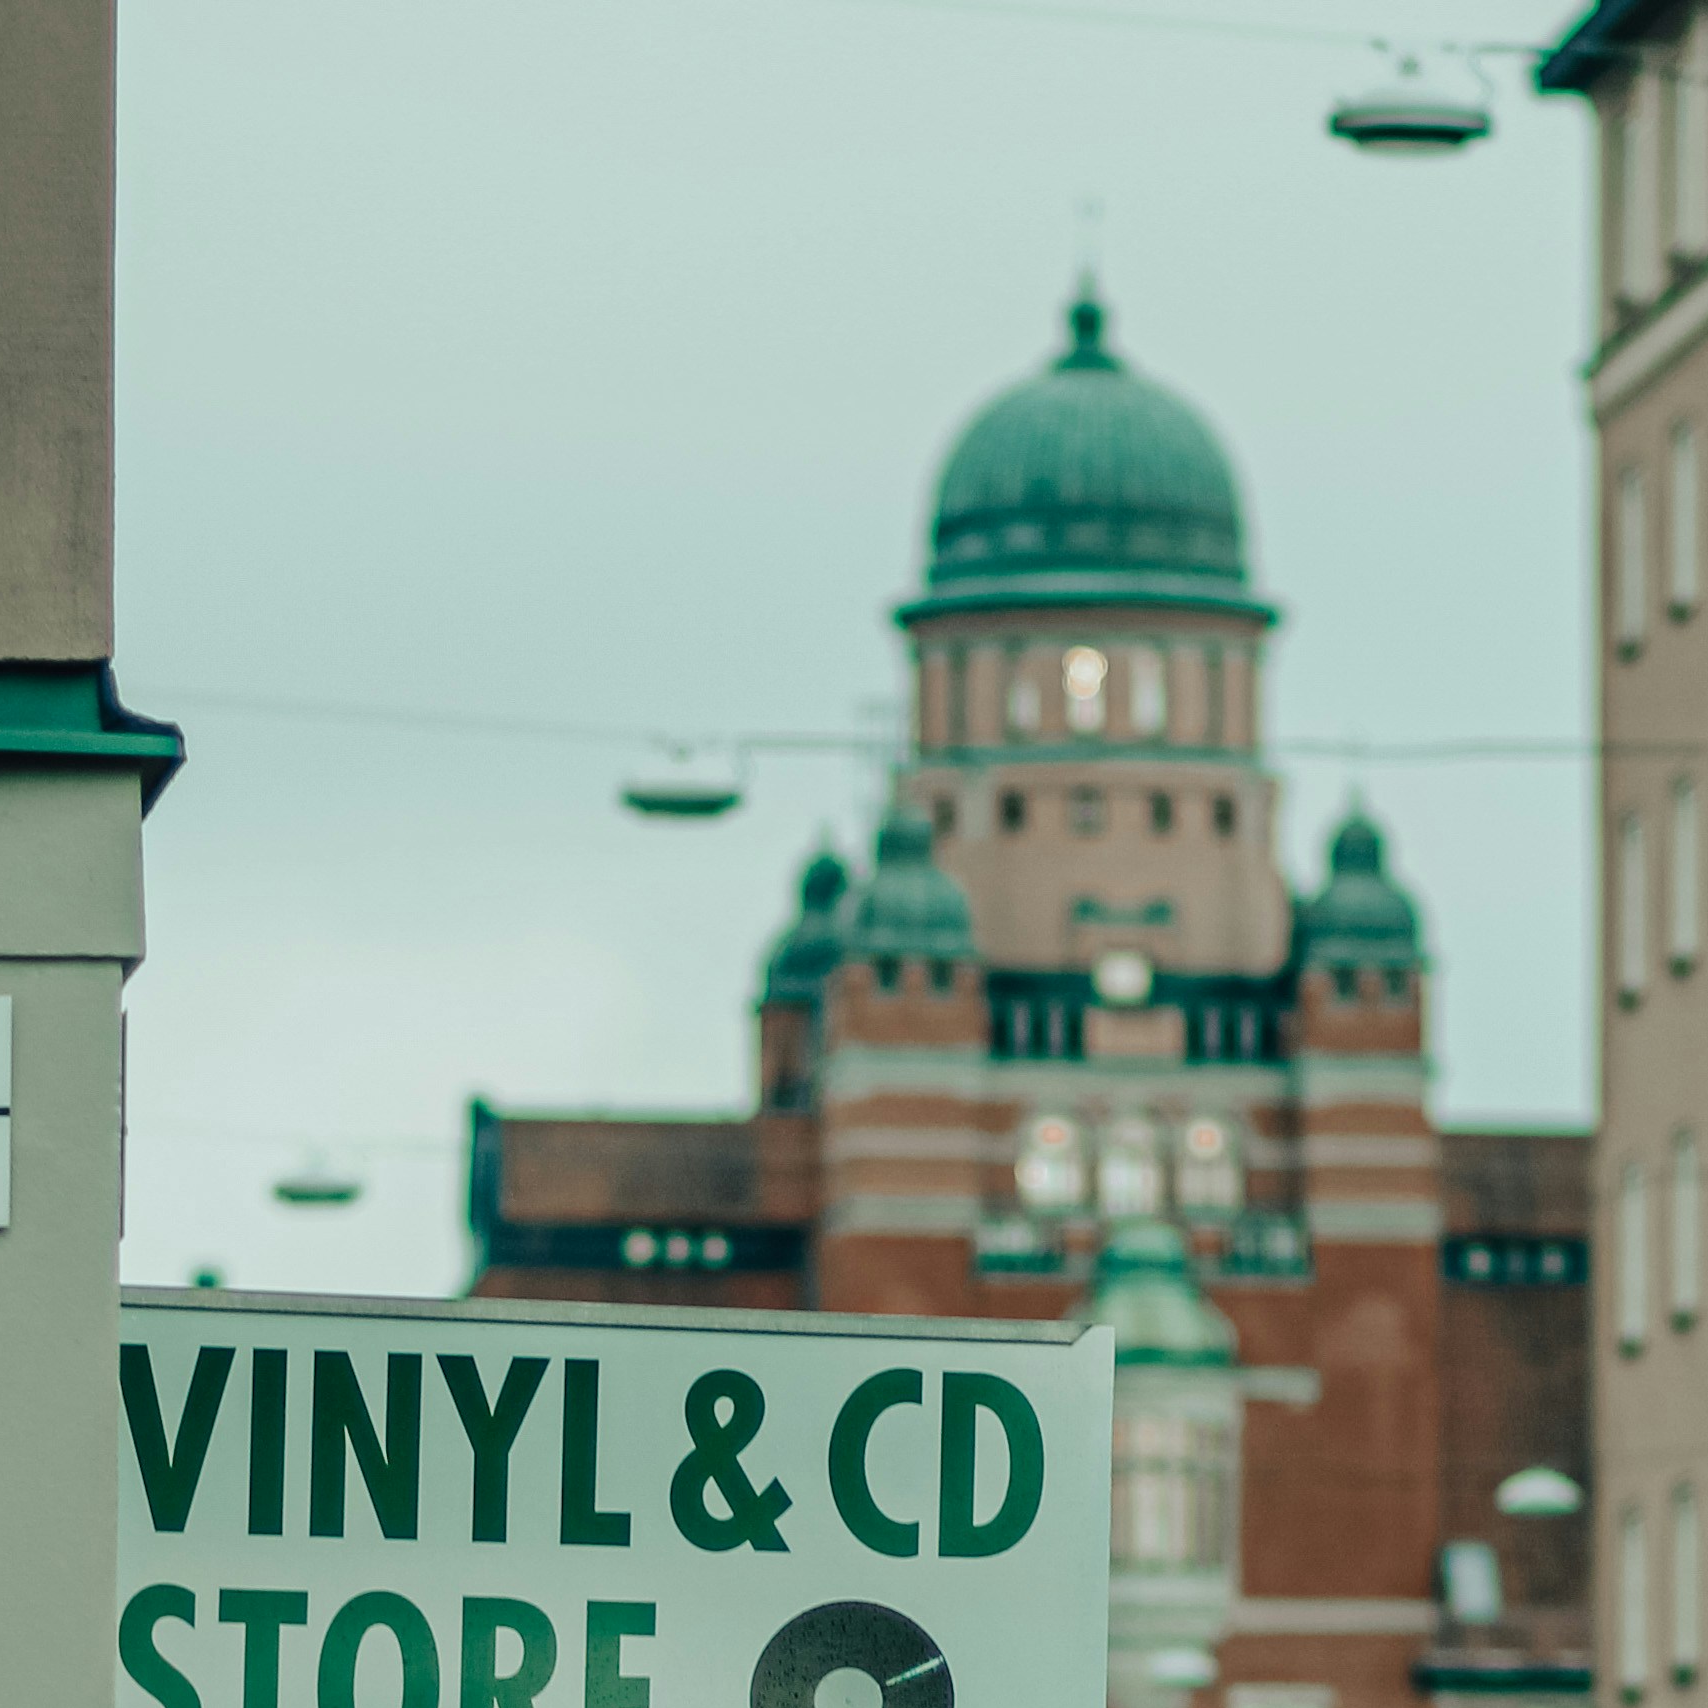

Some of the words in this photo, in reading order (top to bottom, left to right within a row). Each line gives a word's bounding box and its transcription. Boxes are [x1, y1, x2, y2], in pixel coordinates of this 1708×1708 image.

[119, 1343, 632, 1547] VINYL
[669, 1368, 793, 1553] &
[827, 1368, 1045, 1558] CD
